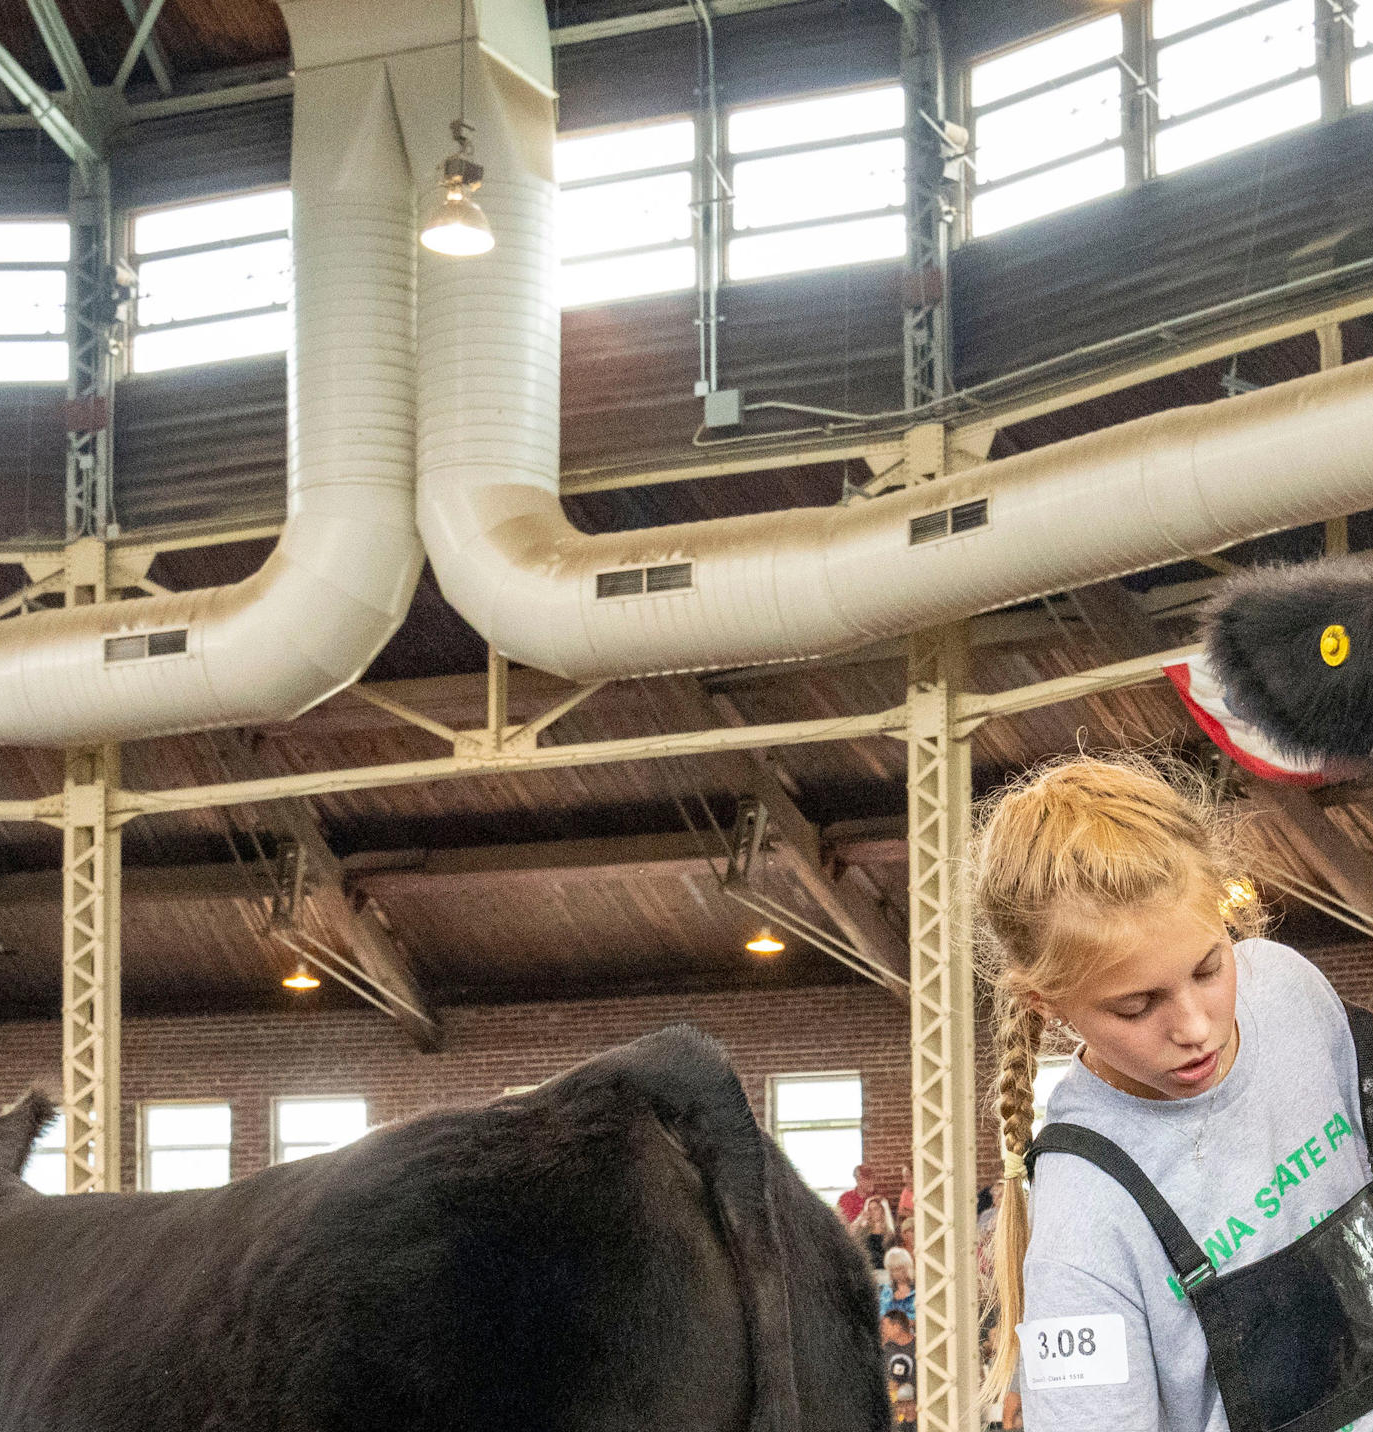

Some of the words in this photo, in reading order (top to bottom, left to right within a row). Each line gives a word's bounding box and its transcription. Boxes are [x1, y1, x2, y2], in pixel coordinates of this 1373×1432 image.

[1166, 1216, 1258, 1301] IWA
[1254, 1136, 1327, 1219] STATE
[1038, 1328, 1096, 1360] 3.08
